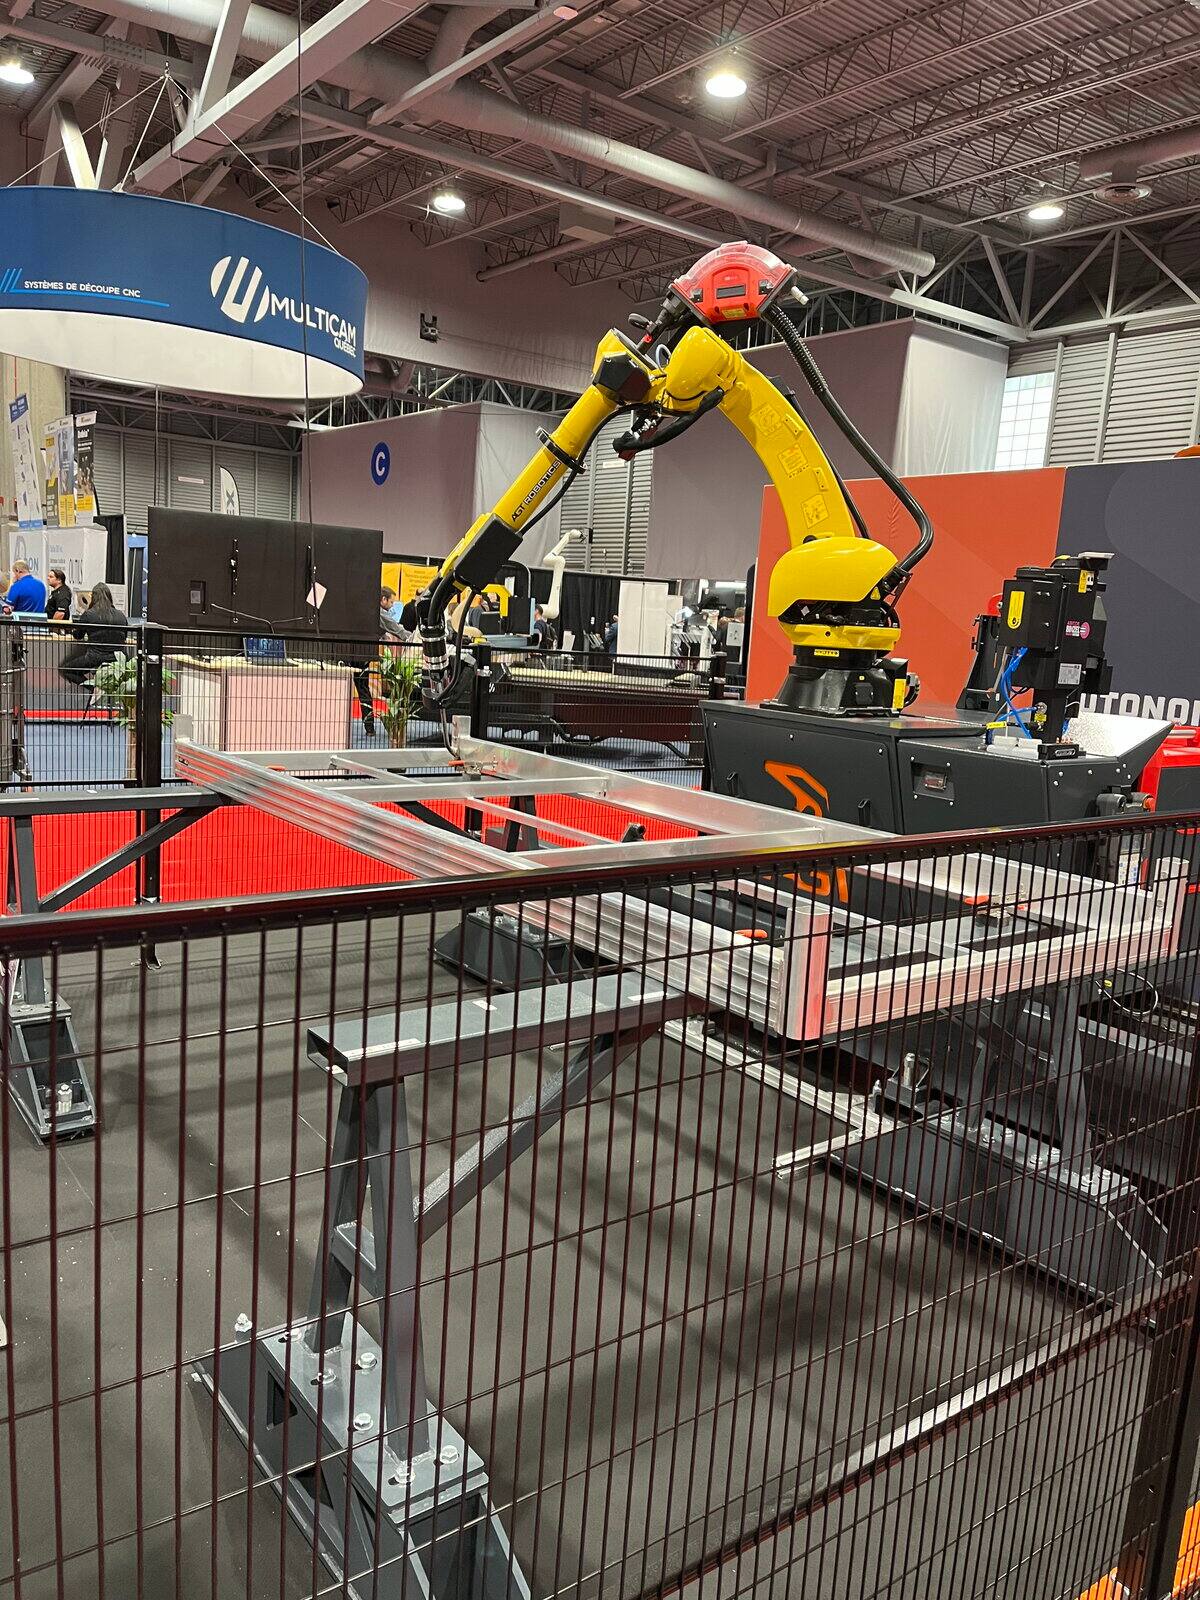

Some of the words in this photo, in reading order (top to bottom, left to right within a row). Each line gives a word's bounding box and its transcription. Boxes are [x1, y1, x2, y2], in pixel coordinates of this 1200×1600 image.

[24, 280, 64, 290] SYSTÈMES
[65, 282, 78, 291] DE
[79, 282, 120, 295] DÉCOUPE
[122, 288, 141, 298] CNC
[271, 293, 356, 347] MULTICAM
[375, 451, 386, 477] C
[511, 503, 525, 523] AGT
[523, 460, 562, 506] ROBOTICS
[1080, 692, 1200, 727] UTONO
